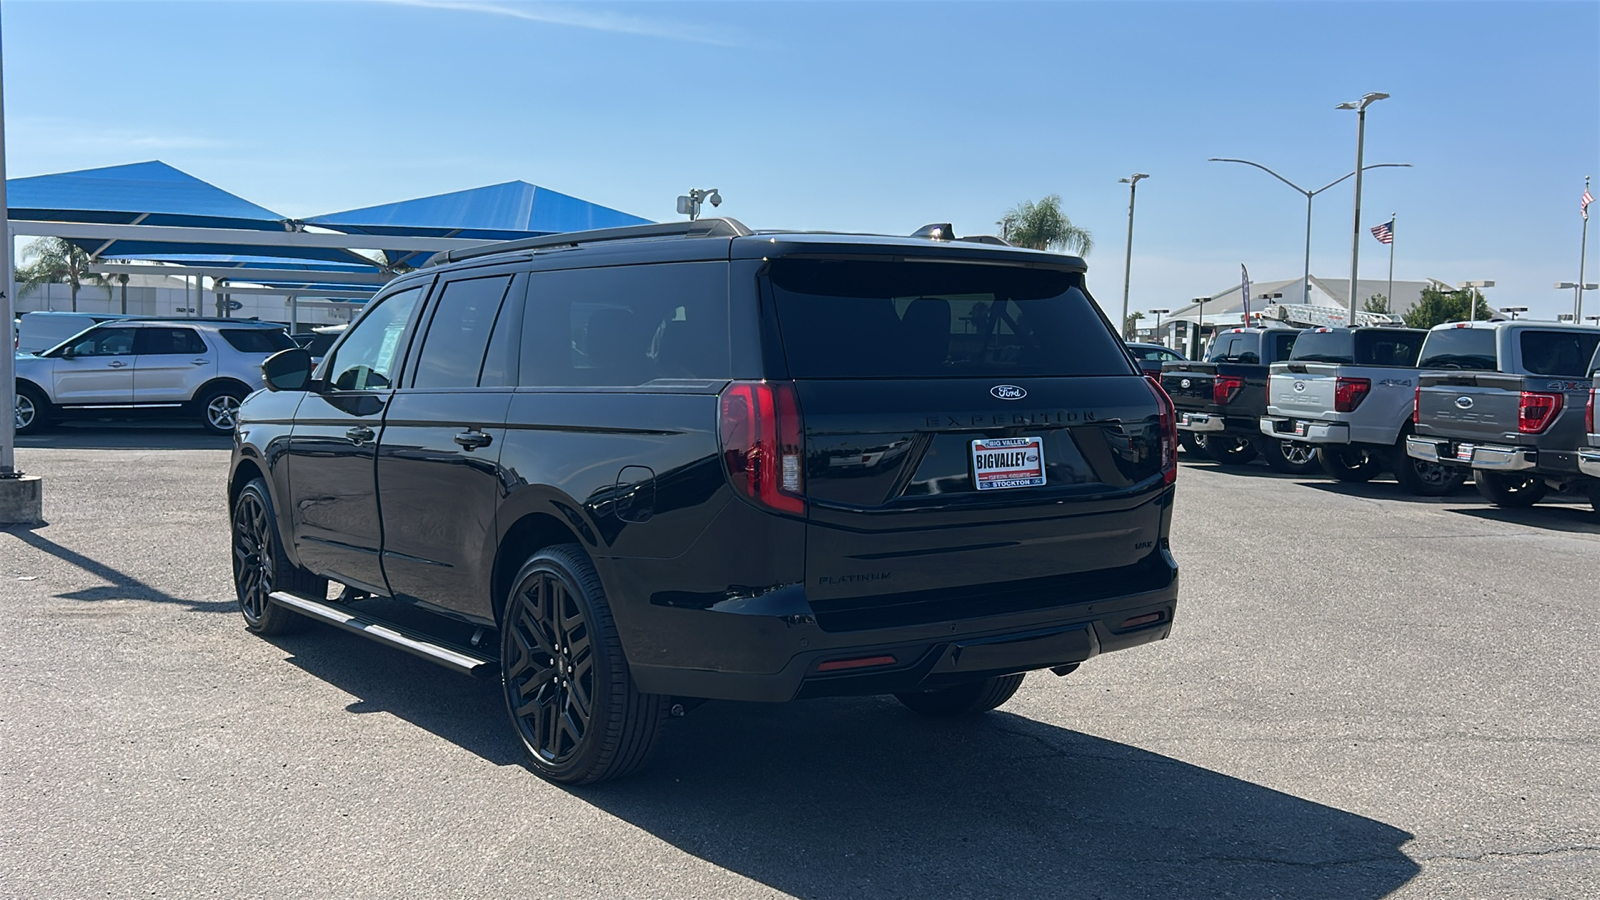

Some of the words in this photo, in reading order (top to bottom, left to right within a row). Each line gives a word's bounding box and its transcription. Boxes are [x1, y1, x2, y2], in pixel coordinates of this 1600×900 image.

[997, 386, 1022, 398] Ford
[926, 411, 1097, 427] EXPEDITION
[976, 452, 1026, 469] BIGVALLEY
[993, 479, 1030, 487] STOCKTON
[819, 571, 891, 584] PLATINUM
